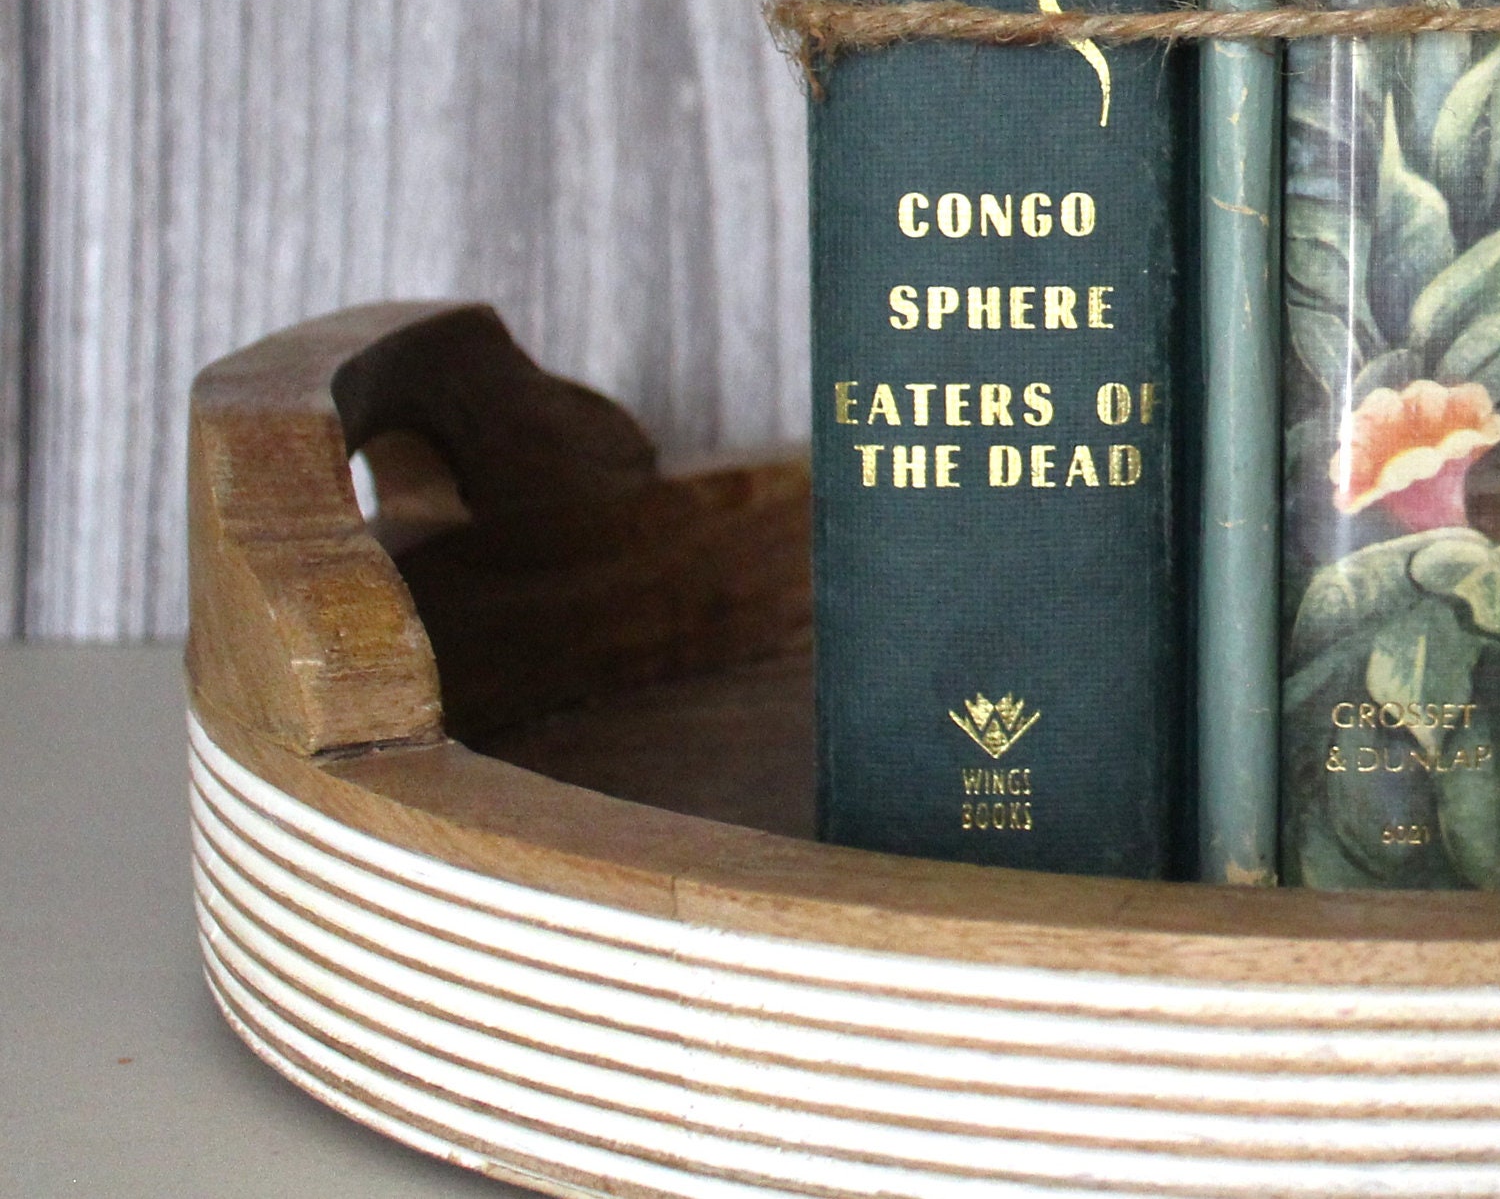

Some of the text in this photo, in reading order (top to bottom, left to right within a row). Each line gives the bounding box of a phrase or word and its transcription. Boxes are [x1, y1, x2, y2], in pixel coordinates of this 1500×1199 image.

[898, 191, 1097, 239] CONGO
[889, 285, 1115, 331] SPHERE
[834, 380, 1162, 427] EATERS OF
[853, 443, 1142, 489] THE DEAD
[1331, 701, 1478, 730] GROSSET
[1325, 745, 1493, 773] & DUNLAP
[962, 767, 1032, 796] WINGS
[961, 801, 1033, 831] BOOKS
